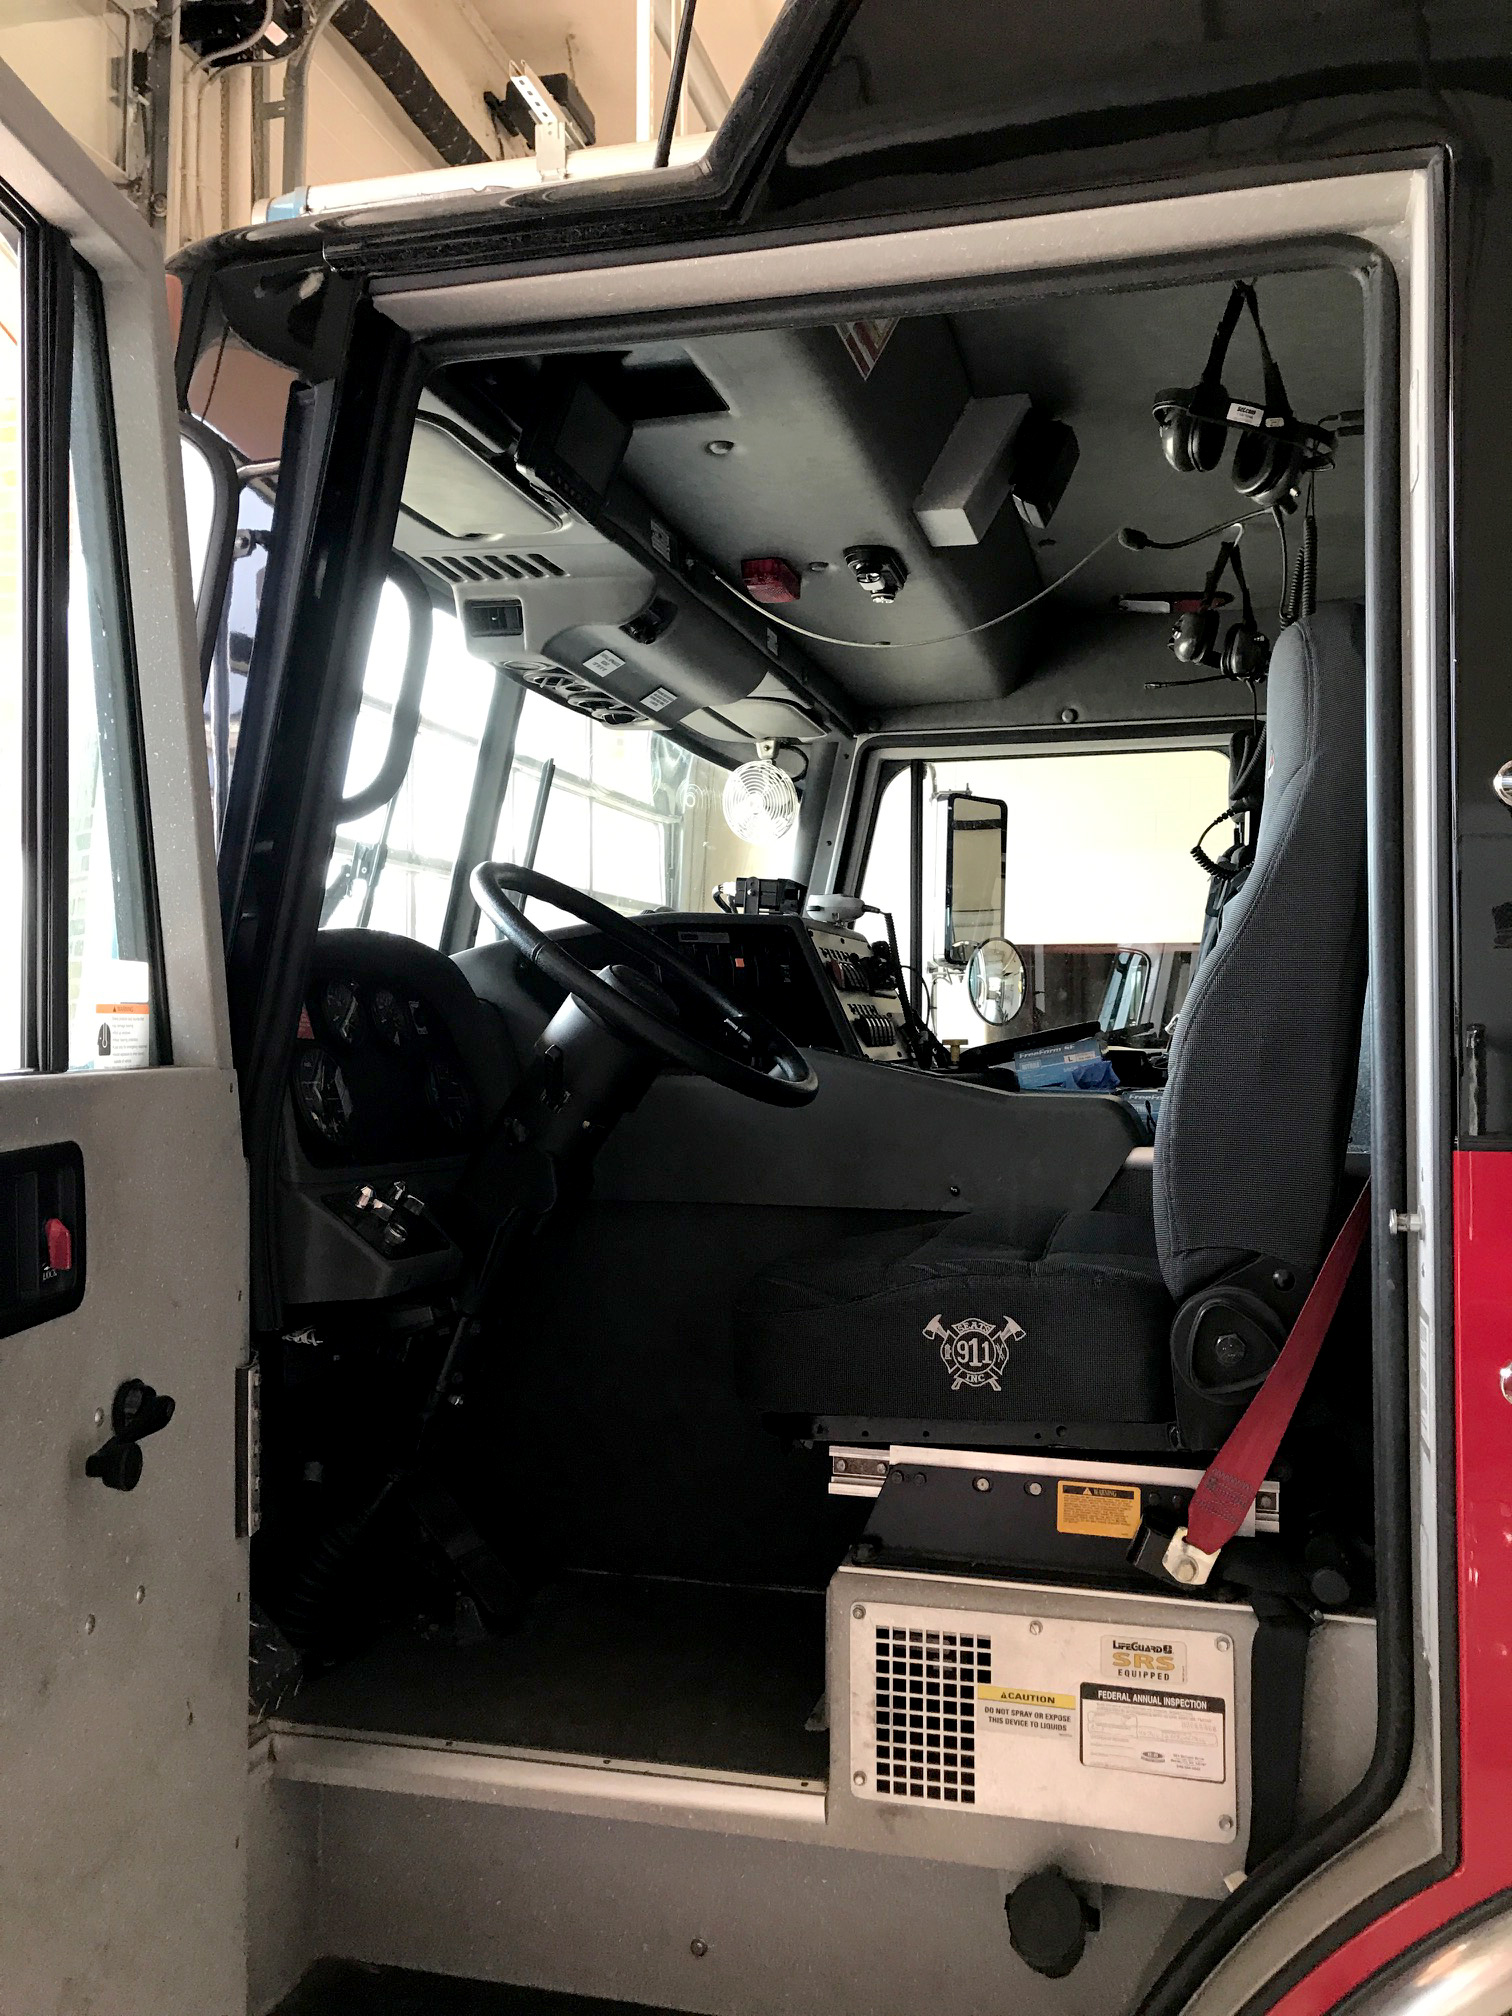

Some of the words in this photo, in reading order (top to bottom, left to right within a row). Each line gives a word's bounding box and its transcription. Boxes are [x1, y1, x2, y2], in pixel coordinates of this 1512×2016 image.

[957, 1321, 991, 1332] SEATS
[956, 1337, 992, 1367] 911
[965, 1374, 985, 1383] INC
[1093, 1488, 1117, 1497] WARNING
[1112, 1652, 1175, 1671] SRS
[1118, 1669, 1170, 1681] EQUIPPED
[1008, 1692, 1056, 1704] CAUTION
[1098, 1690, 1131, 1702] FEDERAL
[1132, 1694, 1162, 1707] ANNUAL
[1163, 1698, 1207, 1710] INSPECTION
[984, 1706, 994, 1714] DO
[996, 1707, 1009, 1715] NOT
[1011, 1709, 1032, 1718] SPRAY
[1045, 1713, 1071, 1723] EXPOSE
[988, 1716, 1004, 1724] THIS
[1005, 1718, 1028, 1727] DEVICE
[1040, 1722, 1067, 1731] LIQUIDS
